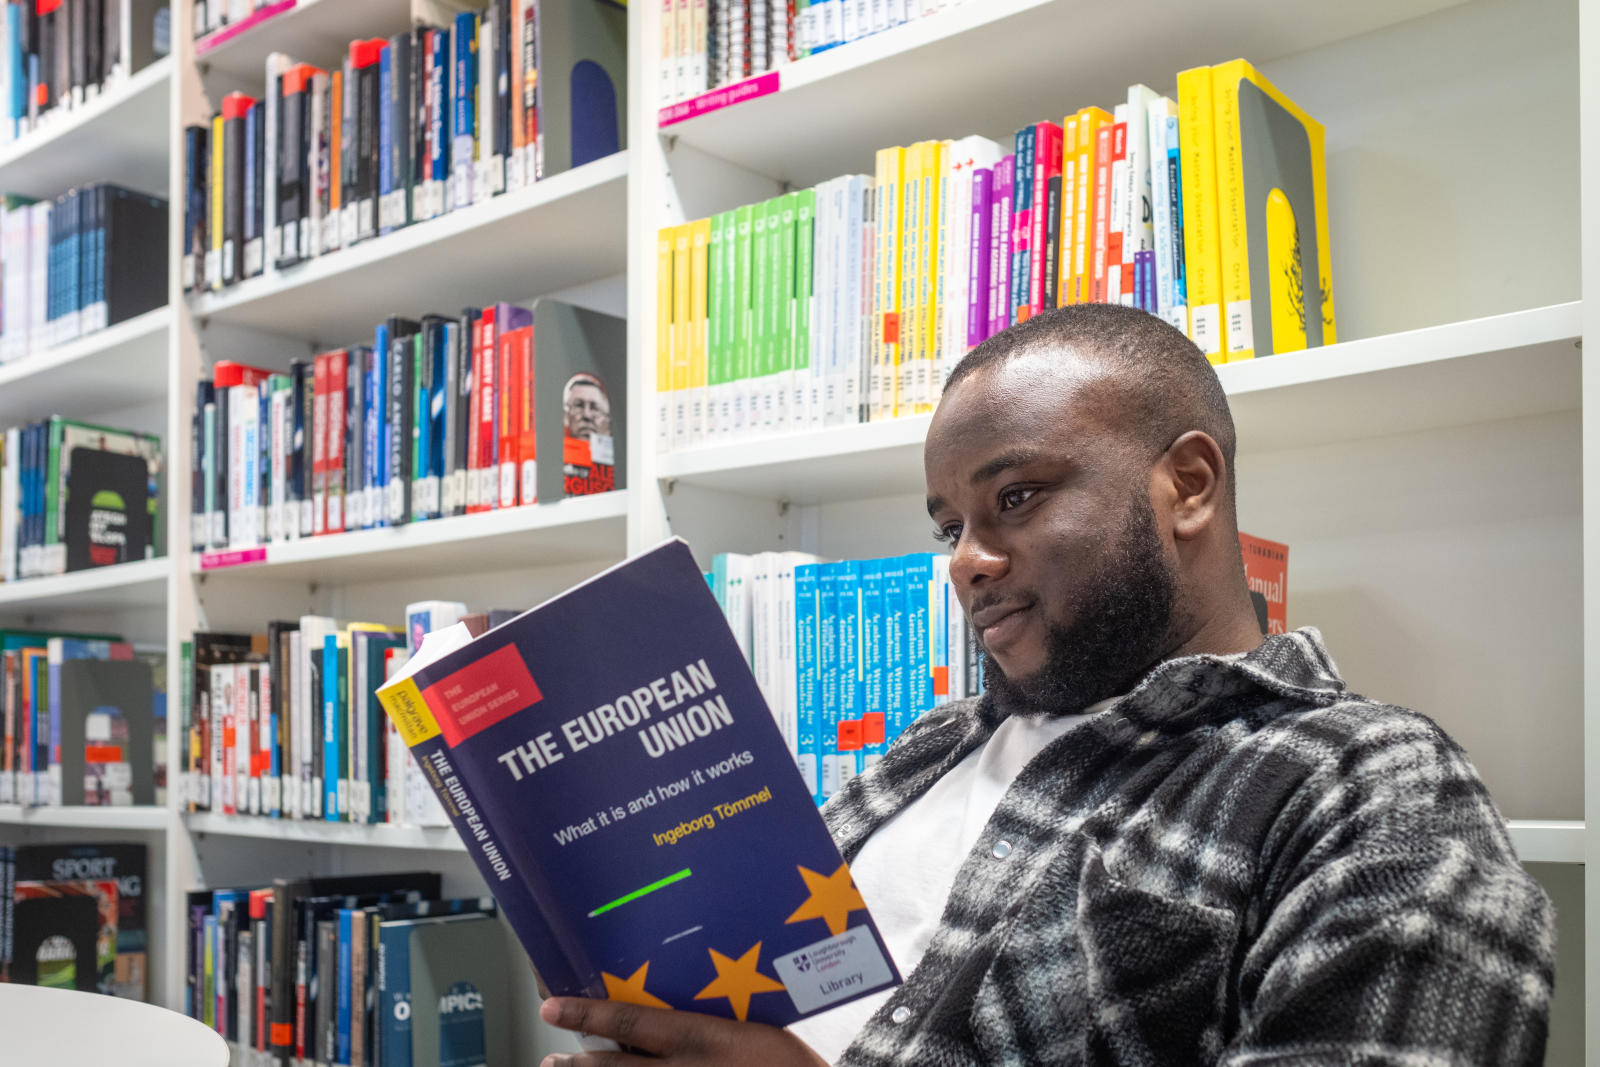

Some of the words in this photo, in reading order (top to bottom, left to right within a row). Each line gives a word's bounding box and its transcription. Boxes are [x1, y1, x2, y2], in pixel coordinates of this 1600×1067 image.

[1228, 146, 1237, 182] Masters
[1230, 186, 1240, 249] Dissertation
[393, 342, 403, 397] CARLO
[1244, 563, 1284, 604] anual
[806, 615, 814, 662] Academic
[847, 614, 855, 663] Academic
[872, 613, 881, 663] Academic
[894, 611, 902, 662] Academic
[917, 607, 926, 659] Academic
[443, 684, 464, 699] THE
[451, 682, 499, 713] EUROPEAN
[806, 668, 814, 706] Writing
[828, 668, 836, 707] Writing
[847, 668, 856, 709] Writing
[872, 668, 881, 709] Writing
[893, 667, 902, 708] Writing
[916, 663, 926, 706] Writing
[397, 690, 429, 734] palgrave
[497, 731, 564, 782] THE
[561, 659, 717, 752] EUROPEAN
[638, 694, 734, 758] UNION
[800, 734, 814, 745] 3
[823, 734, 837, 746] 3
[430, 748, 453, 777] THE
[444, 775, 490, 842] EUROPEAN
[481, 841, 512, 881] UNION
[553, 817, 599, 847] What
[597, 812, 611, 827] it
[609, 806, 626, 821] is
[627, 789, 657, 814] and
[656, 778, 690, 800] how
[690, 770, 706, 786] it
[705, 750, 754, 780] works
[652, 814, 716, 847] Ingeborg
[713, 785, 773, 821] Tömmel
[52, 857, 117, 881] SPORT
[819, 972, 864, 996] Library
